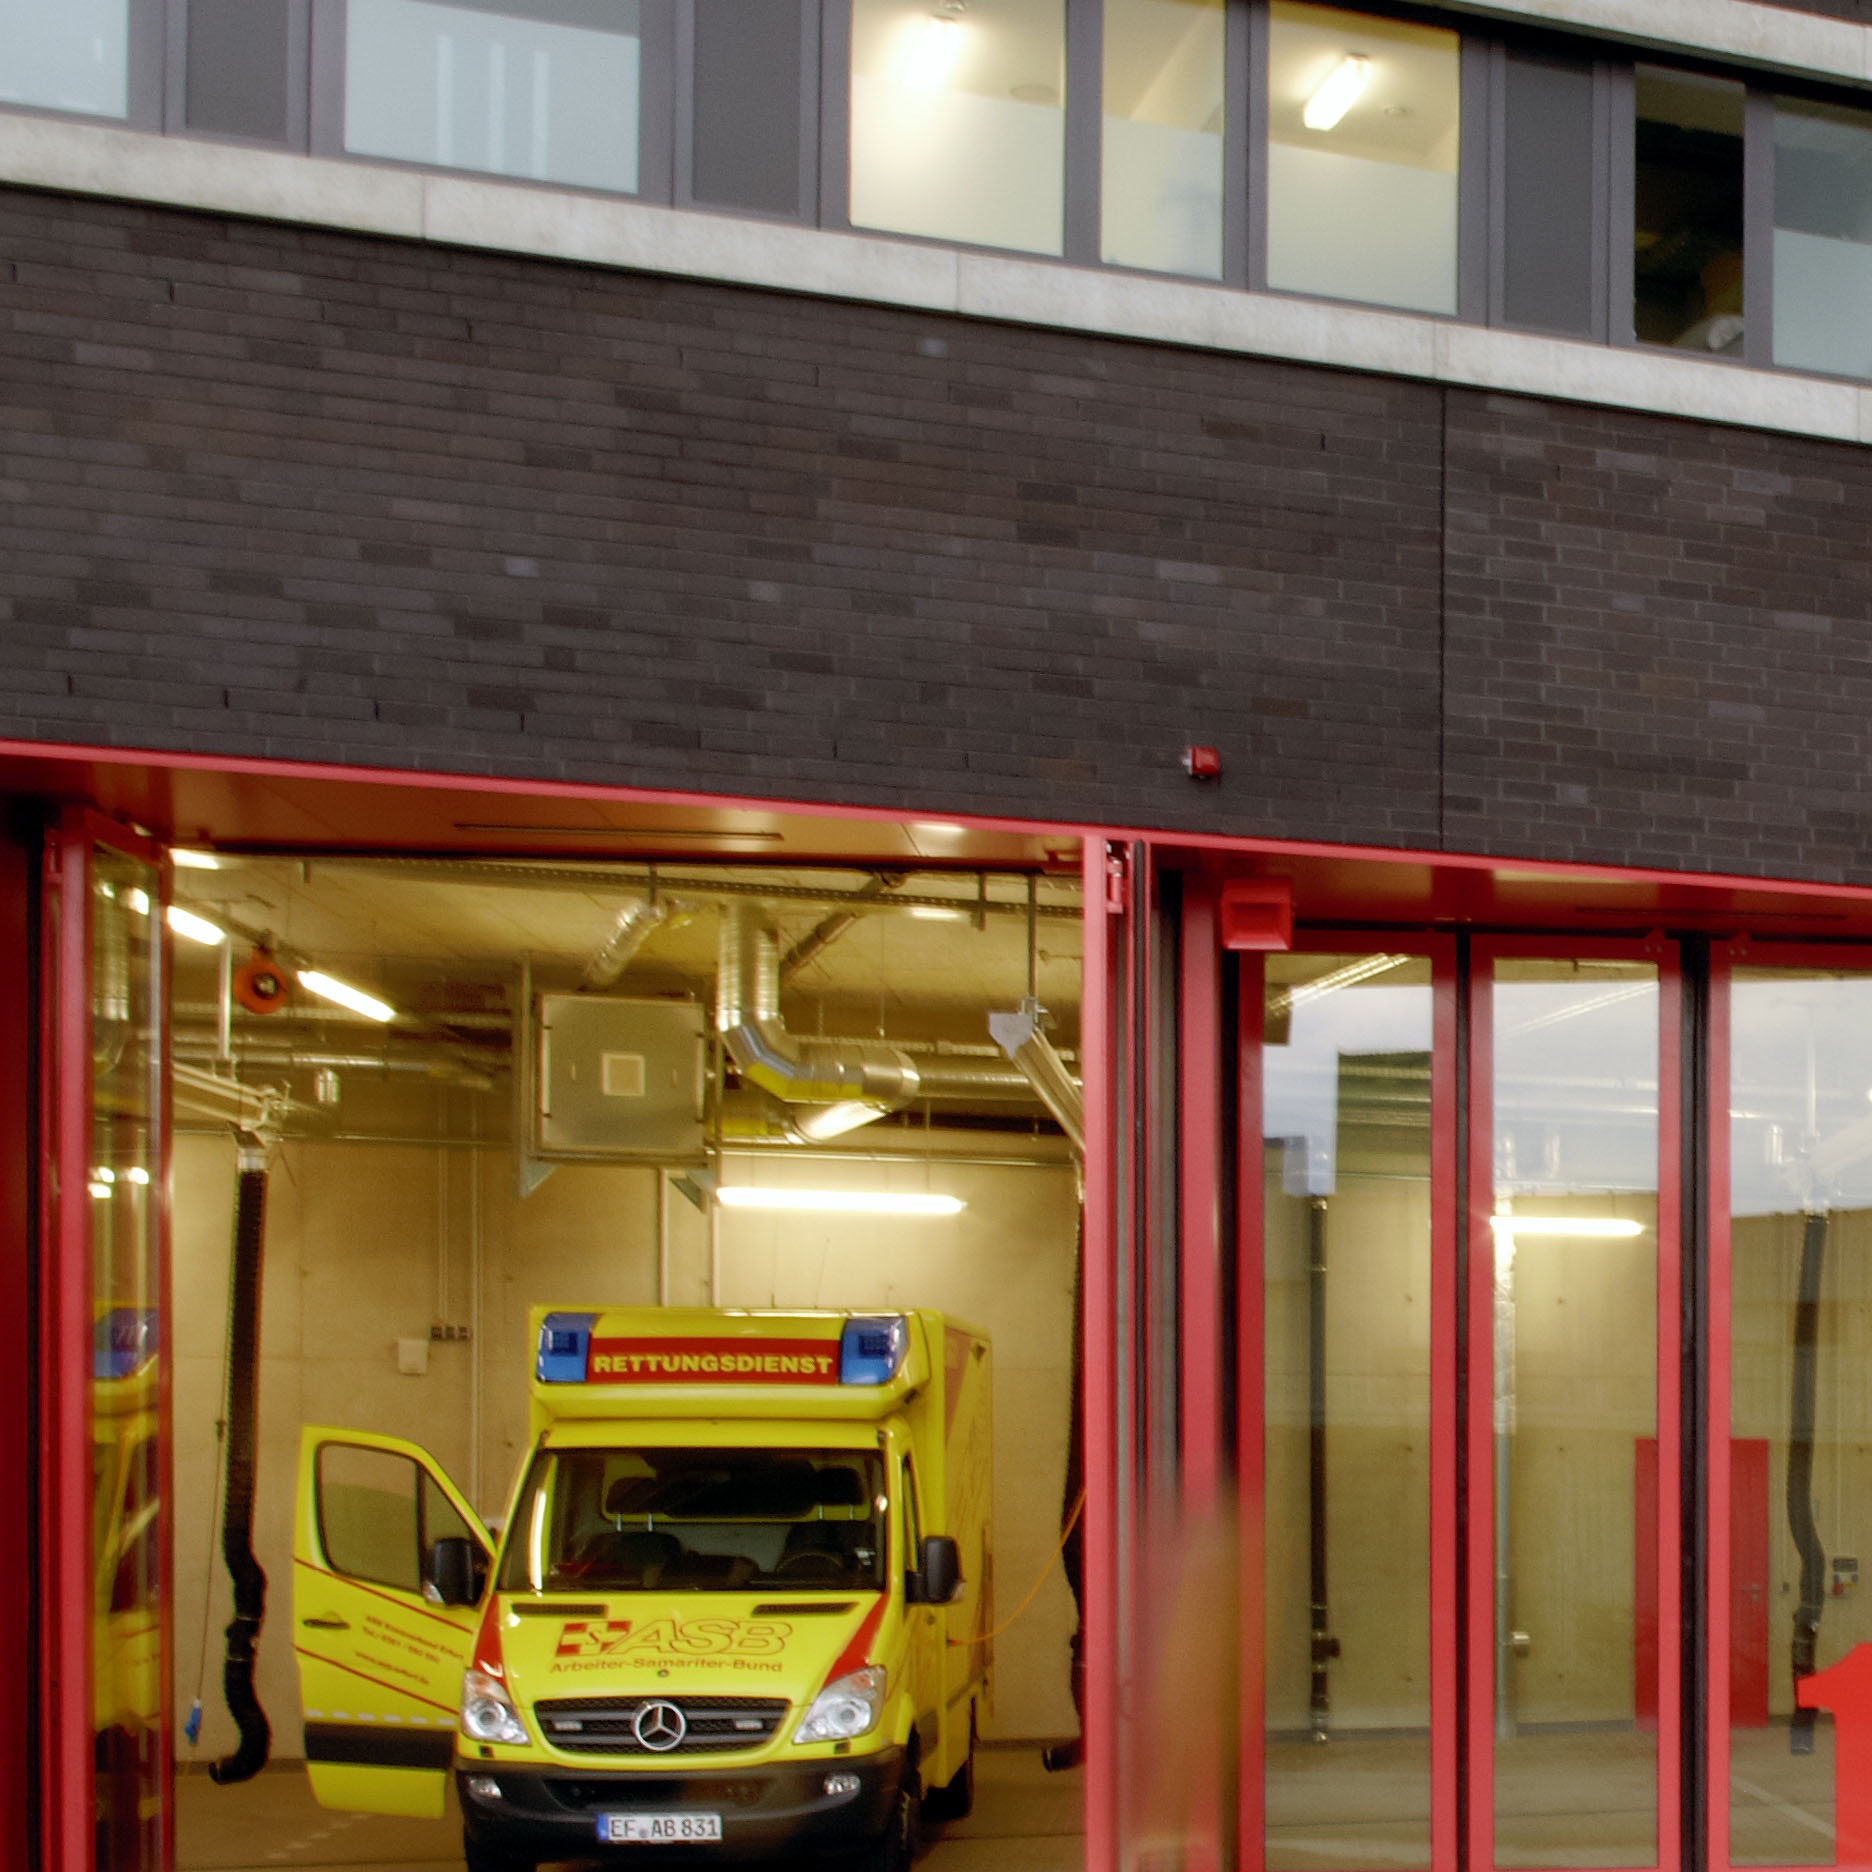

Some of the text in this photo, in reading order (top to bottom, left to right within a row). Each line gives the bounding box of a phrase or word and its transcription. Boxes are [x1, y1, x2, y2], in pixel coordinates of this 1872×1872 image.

[593, 1353, 833, 1375] RETTUNGSDIENST
[607, 1619, 793, 1656] ASB
[550, 1657, 783, 1674] Arbeiter-Samariter-Bund
[610, 1818, 718, 1838] EF AB 831
